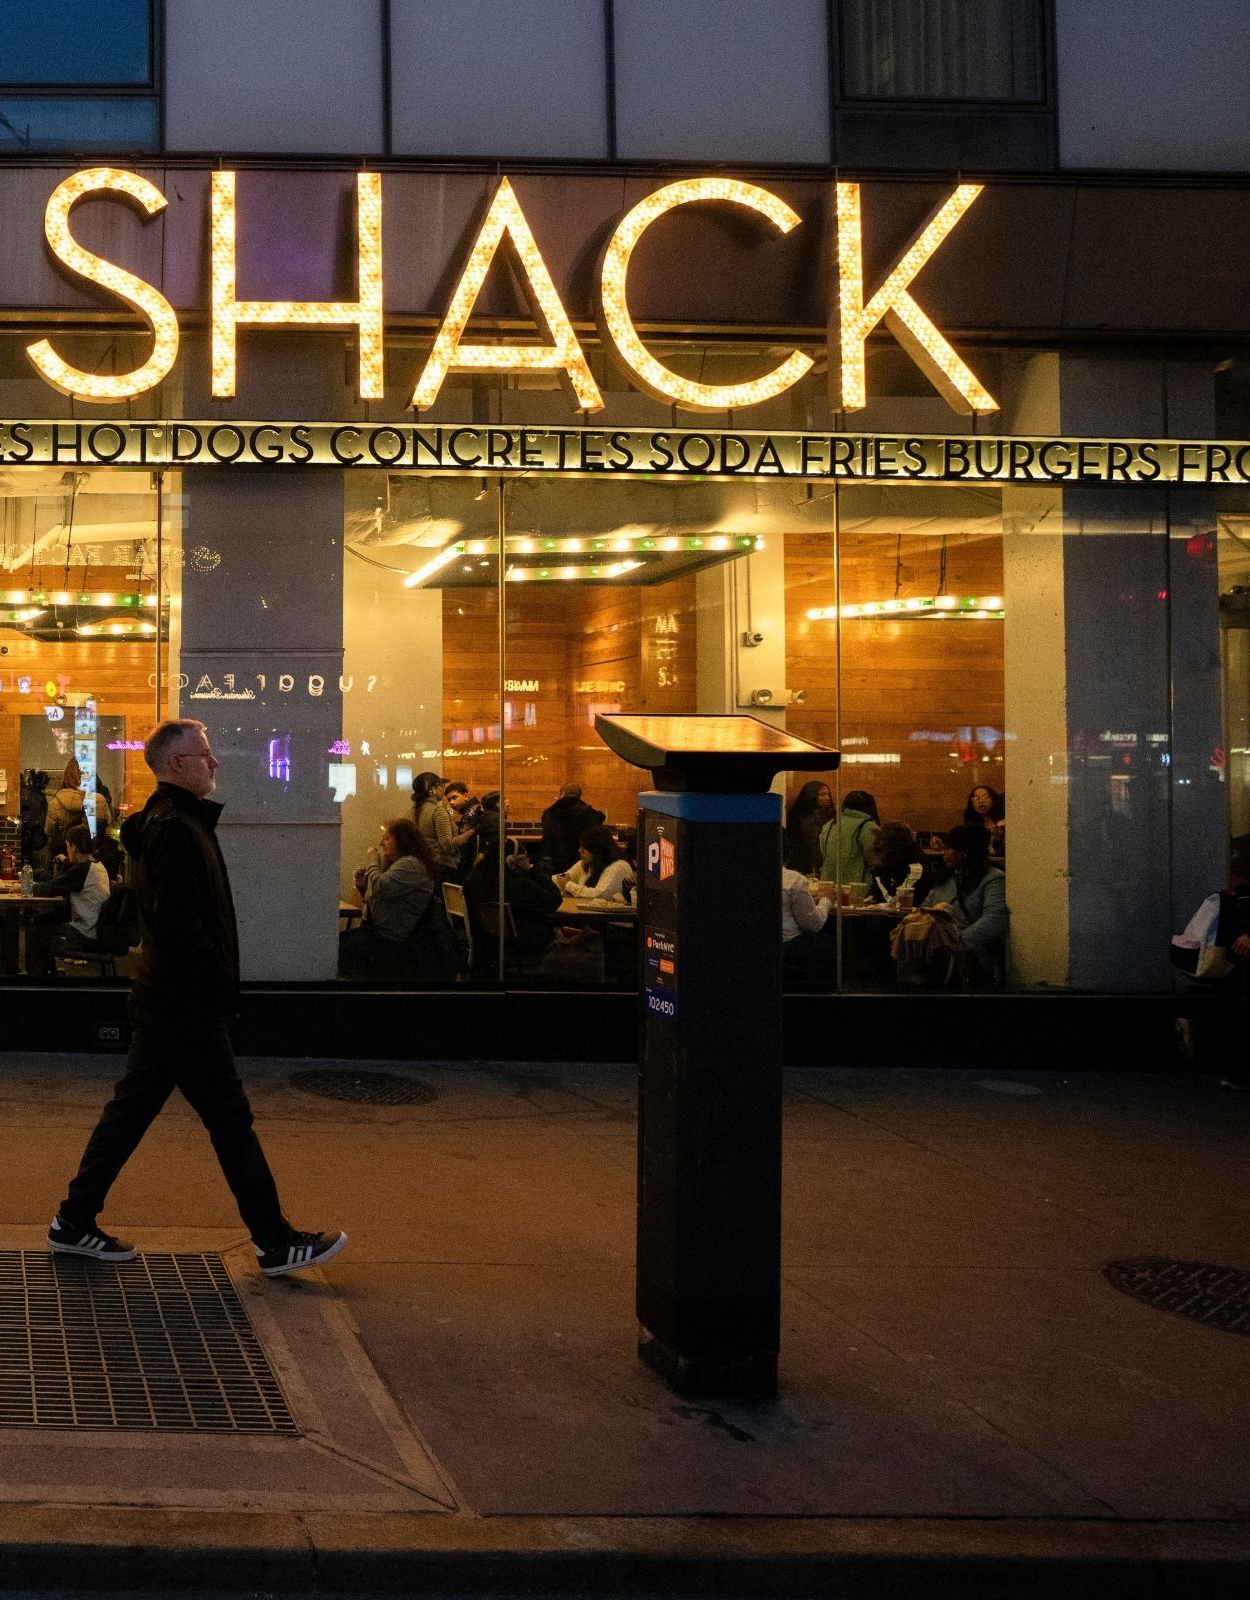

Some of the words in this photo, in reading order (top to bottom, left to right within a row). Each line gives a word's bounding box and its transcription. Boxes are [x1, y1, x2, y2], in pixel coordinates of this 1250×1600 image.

[26, 168, 1000, 412] SHACK
[51, 423, 163, 463] HOT
[171, 423, 312, 464] DOGS
[330, 425, 633, 470] CONCRETES
[650, 432, 791, 474] SODA
[801, 436, 927, 477] FRIES
[943, 438, 1161, 481] BURGERS
[648, 995, 675, 1016] 102450
